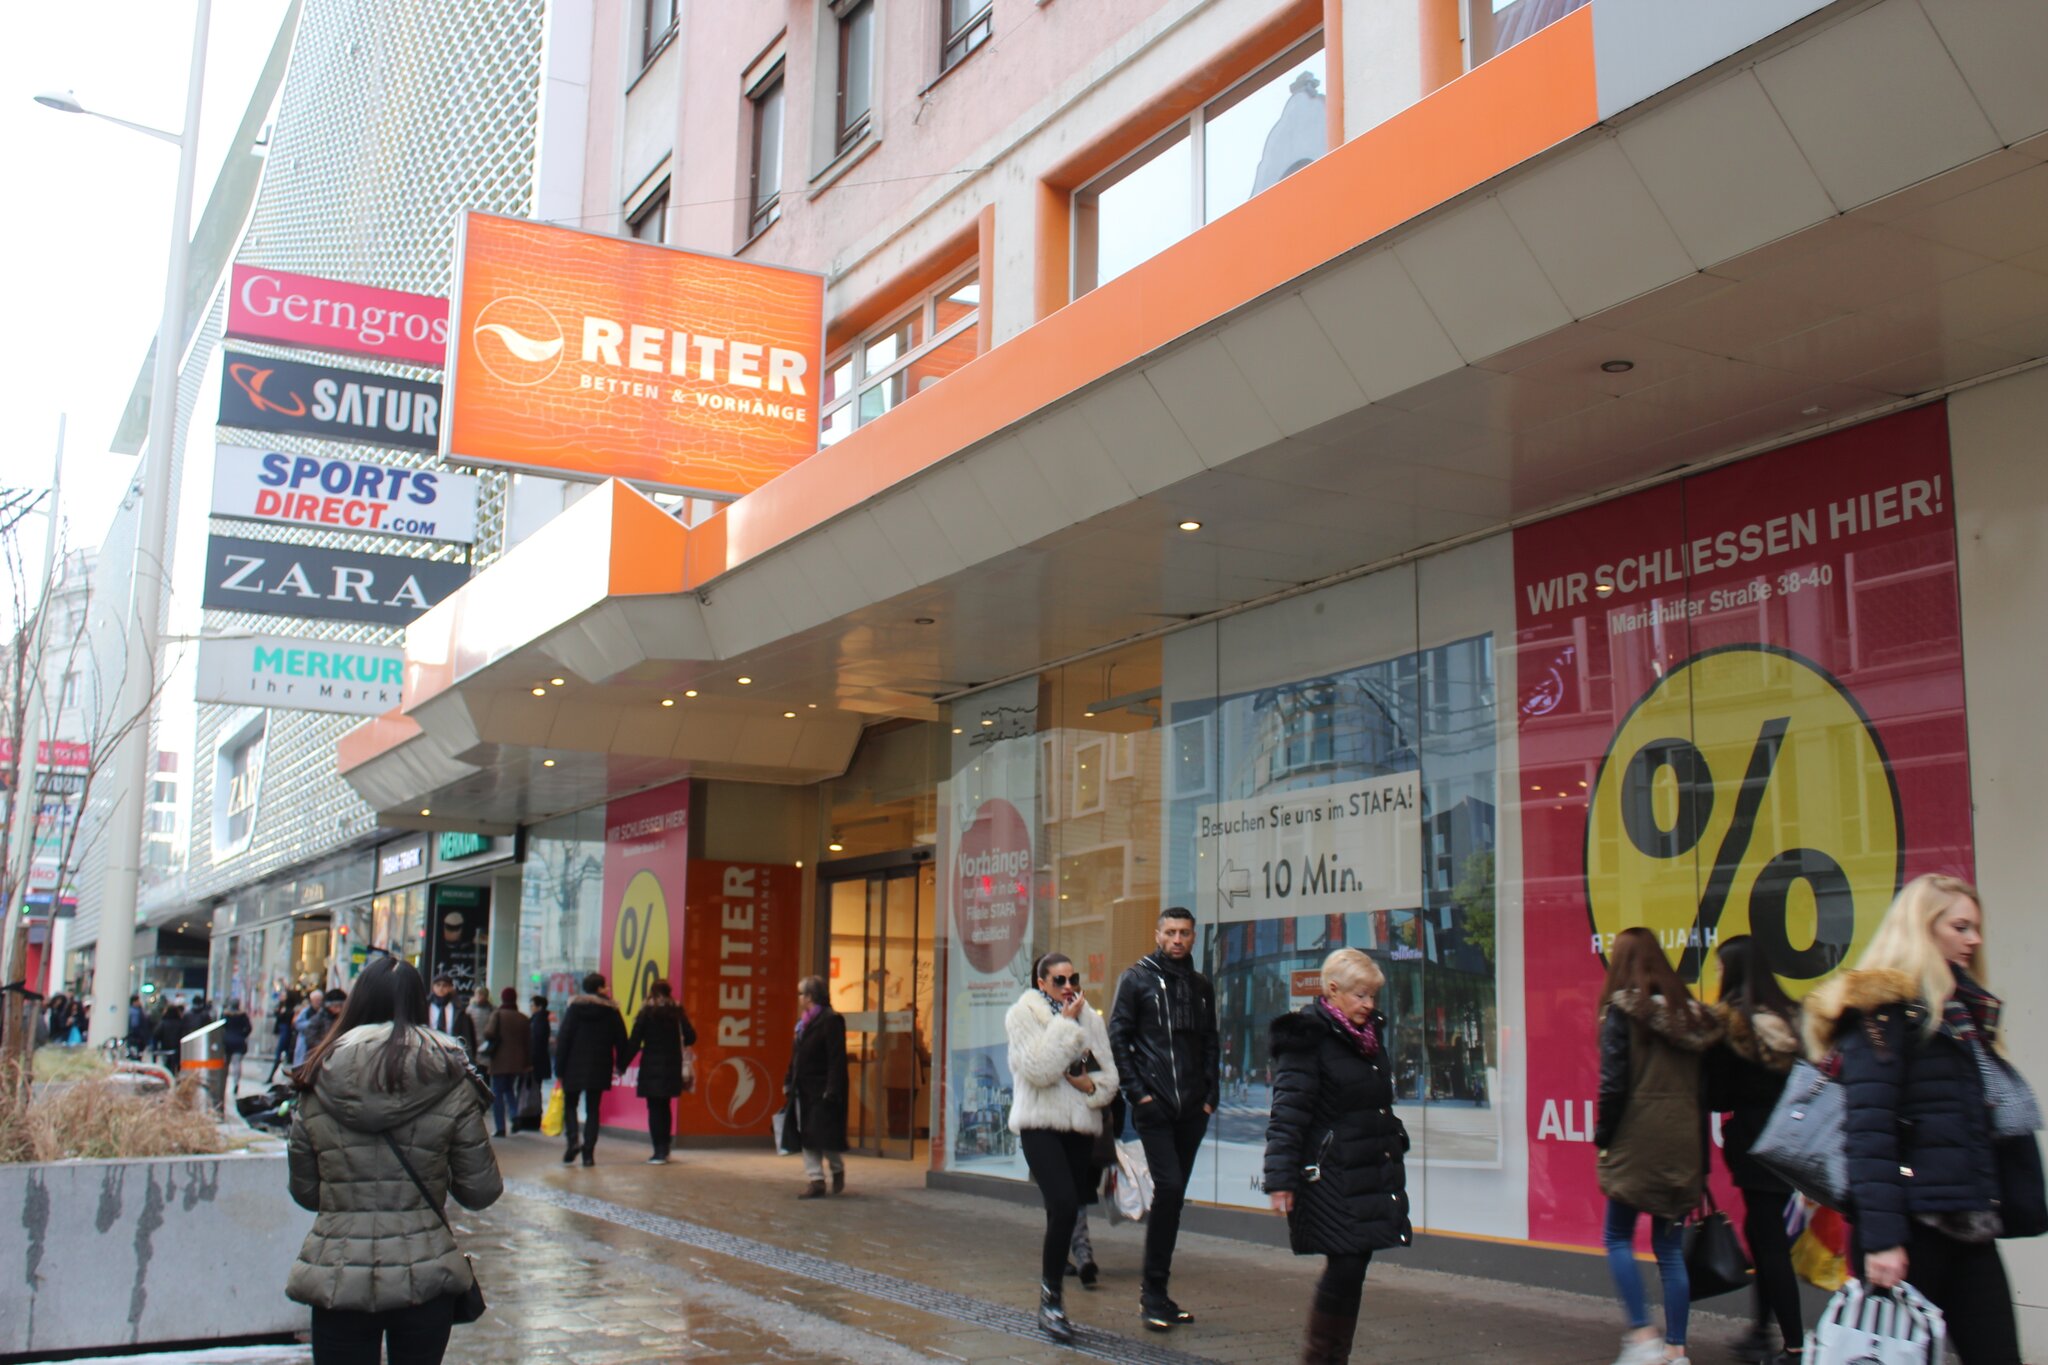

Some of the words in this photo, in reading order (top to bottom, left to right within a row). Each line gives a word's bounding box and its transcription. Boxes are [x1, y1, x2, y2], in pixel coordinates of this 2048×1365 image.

[581, 315, 808, 396] REITER
[311, 378, 438, 436] SATUR
[580, 374, 659, 399] BETTEN
[671, 389, 686, 404] &
[257, 452, 439, 505] SPORTS
[1526, 571, 1588, 615] WIR
[1595, 508, 1818, 593] SCHLIESSEN
[1828, 474, 1944, 540] HIER!
[219, 554, 435, 609] ZARA
[1612, 598, 1705, 635] Mariahilfer
[1709, 580, 1772, 612] Straße
[1776, 564, 1834, 596] 38-40
[250, 677, 295, 695] Ihr
[252, 645, 404, 685] MERKUR
[1201, 811, 1265, 838] Besuchen
[1269, 804, 1292, 828] Sie
[1295, 804, 1322, 825] uns
[1327, 799, 1344, 821] im
[1349, 784, 1413, 818] STAFA!
[959, 847, 1029, 878] Vorhänge
[1262, 858, 1292, 900] 10
[1301, 853, 1363, 896] Min.
[717, 866, 756, 1047] REITER
